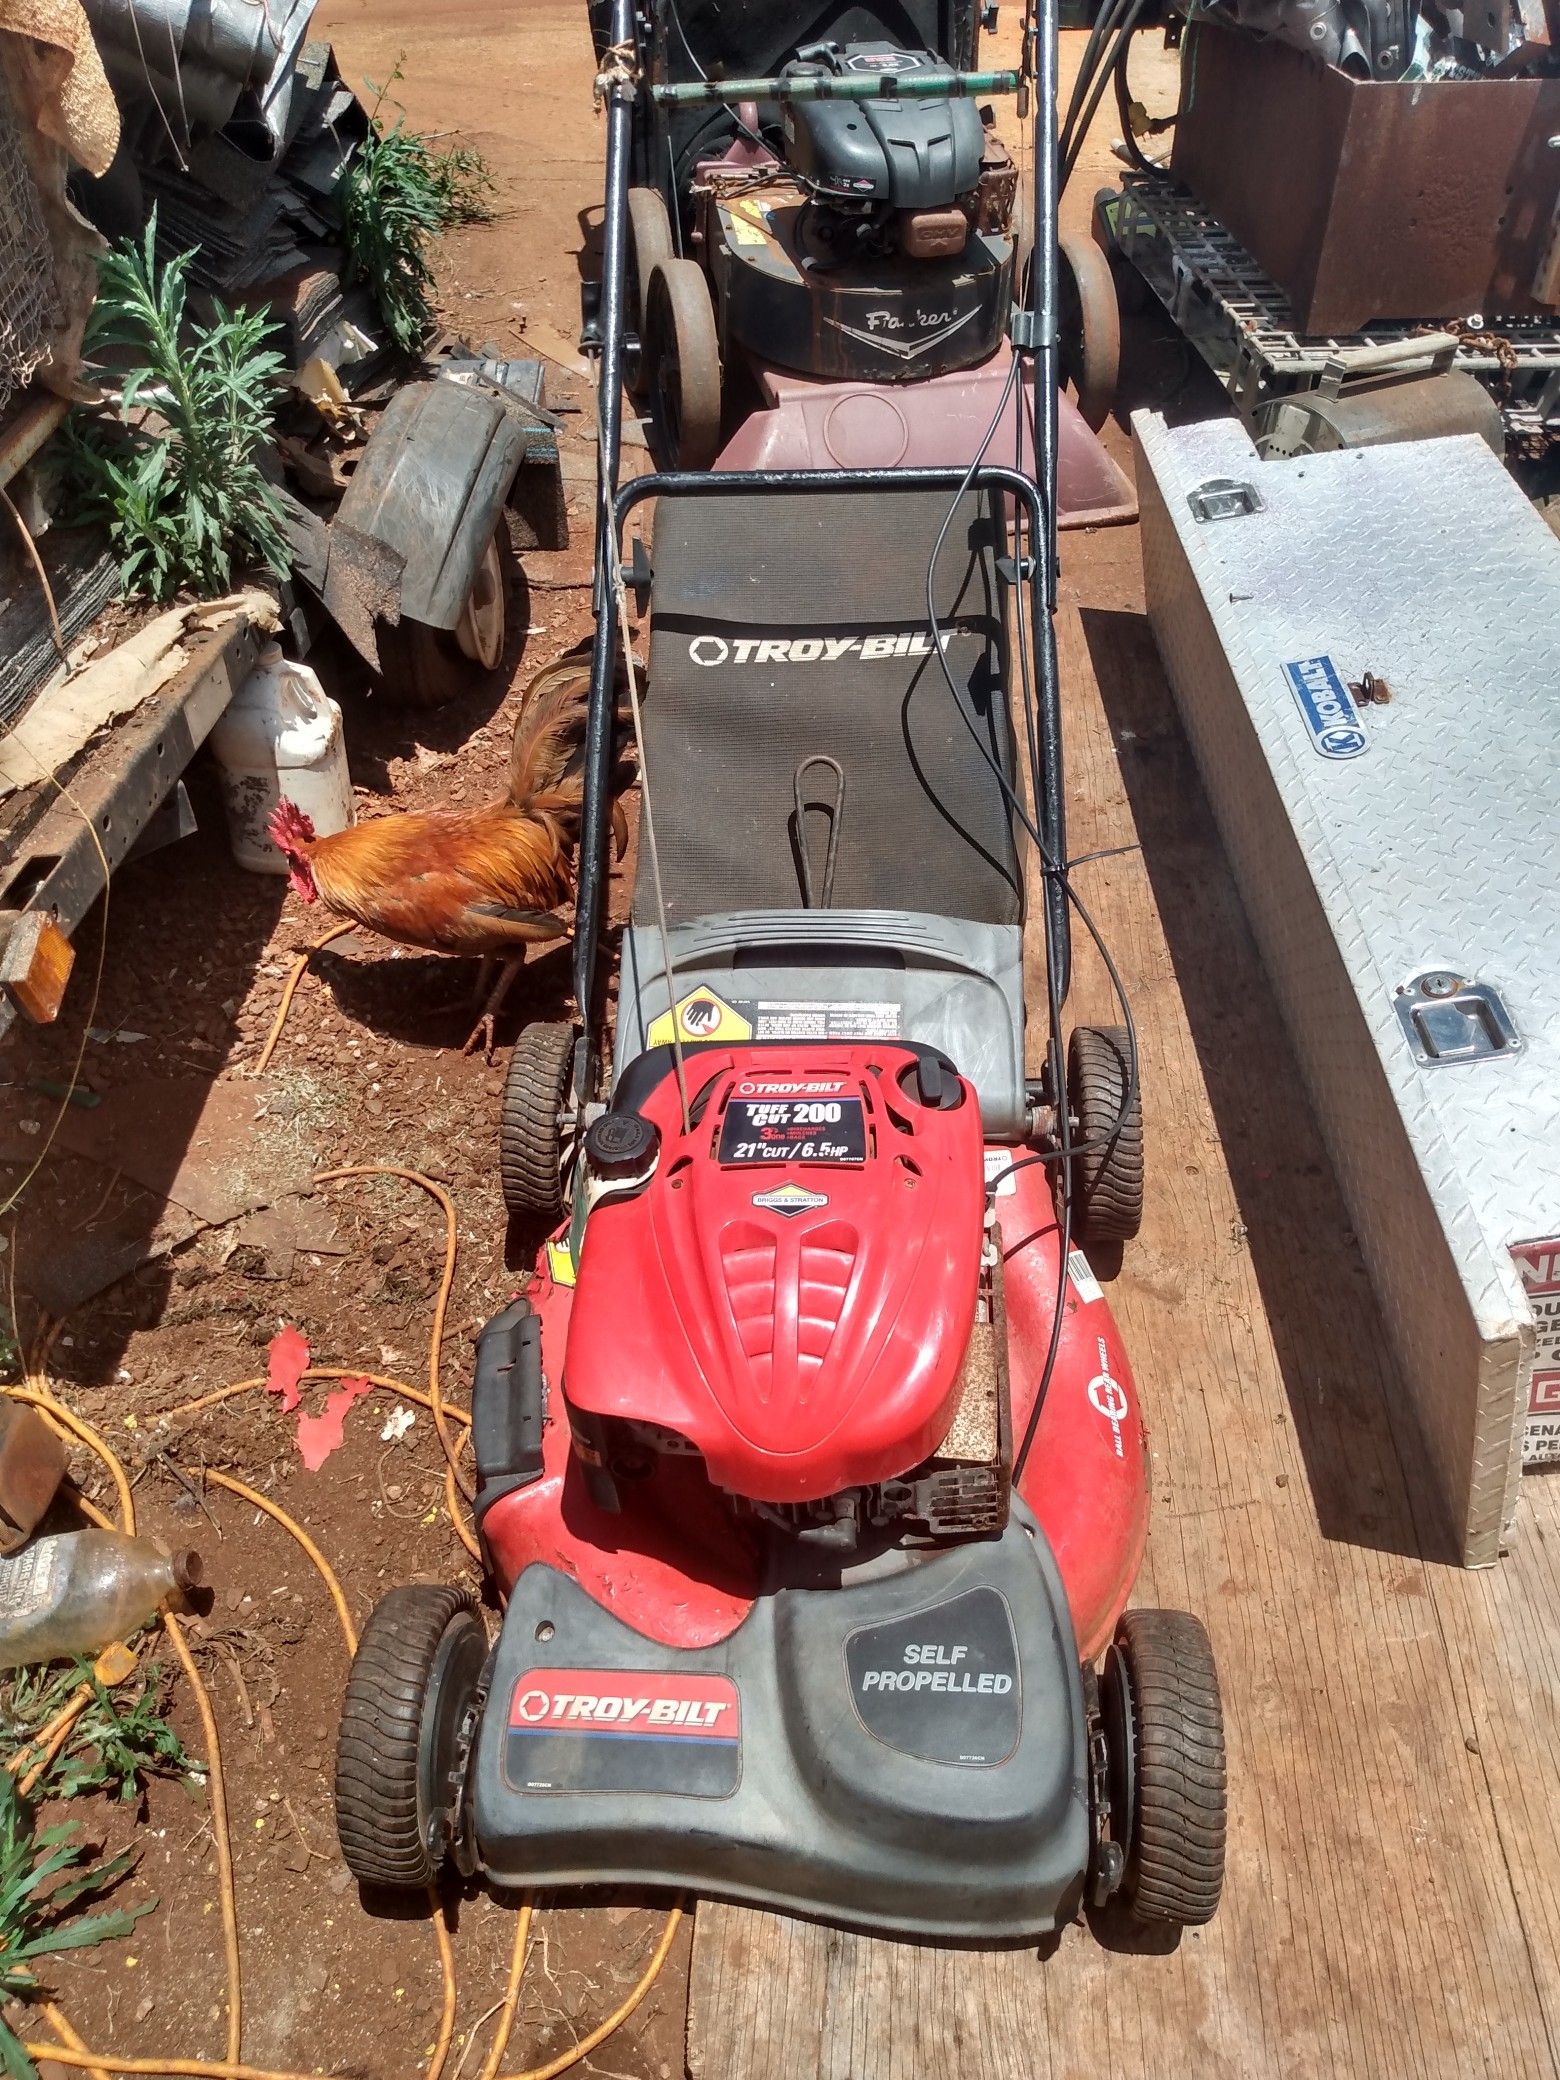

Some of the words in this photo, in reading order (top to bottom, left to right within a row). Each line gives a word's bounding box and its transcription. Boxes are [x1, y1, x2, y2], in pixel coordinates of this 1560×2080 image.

[733, 628, 958, 664] TROY-BILT
[1297, 660, 1349, 728] KOBALT
[756, 1081, 847, 1095] TROY-BILT
[746, 1103, 790, 1117] TUFF
[752, 1113, 792, 1127] CUT
[793, 1103, 842, 1123] 200
[1097, 1336, 1109, 1371] WHEELS
[1107, 1395, 1121, 1434] BEARING
[1114, 1434, 1124, 1458] BALL
[903, 1644, 968, 1665] SELF
[862, 1670, 1012, 1694] PROPELLED
[551, 1694, 728, 1727] TROY-BILT
